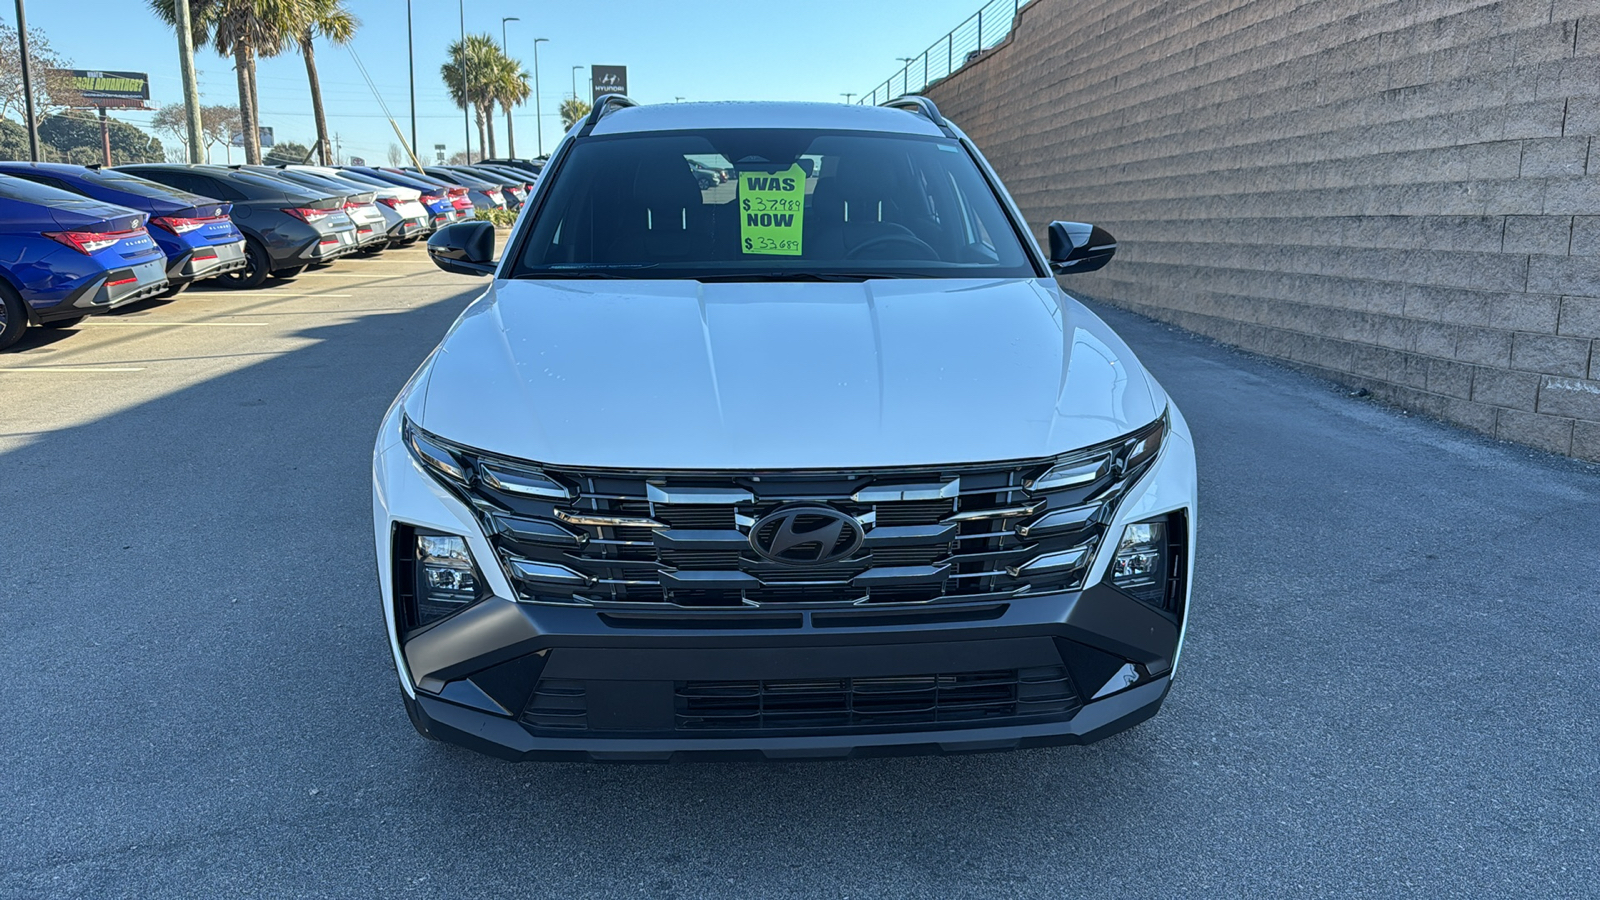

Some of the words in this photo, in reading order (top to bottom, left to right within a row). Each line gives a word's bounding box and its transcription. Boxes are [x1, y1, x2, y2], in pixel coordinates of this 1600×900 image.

[94, 77, 144, 92] ADVANTAGE?
[747, 177, 796, 191] WAS
[742, 198, 751, 212] $
[747, 213, 794, 227] NOW
[744, 237, 753, 250] $
